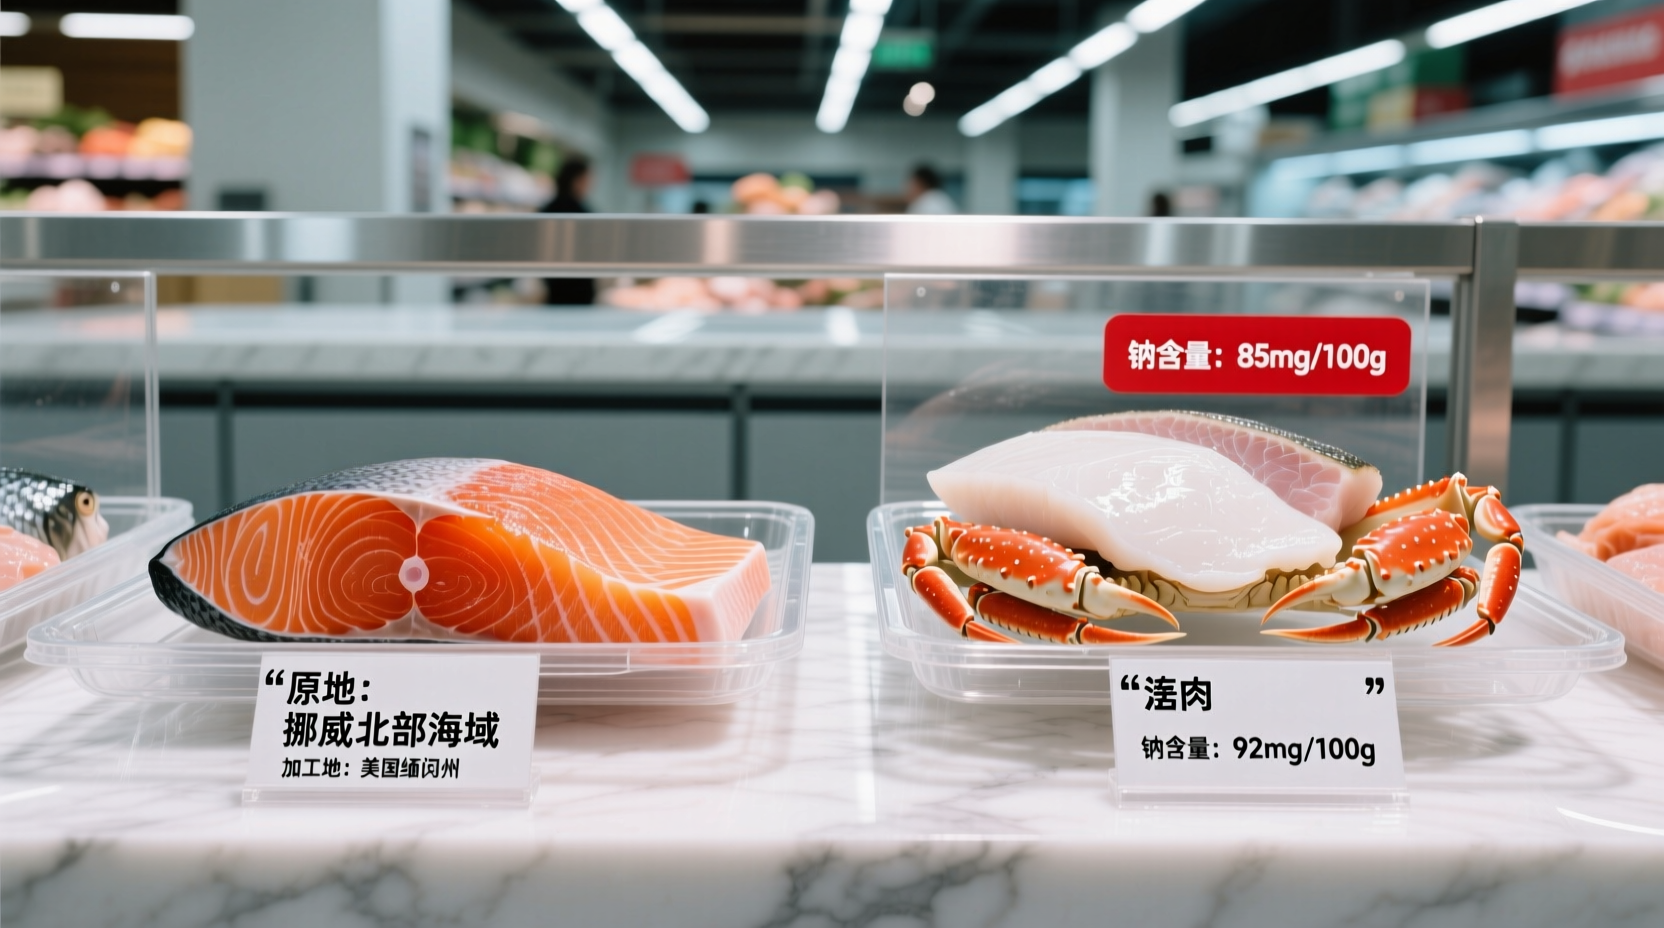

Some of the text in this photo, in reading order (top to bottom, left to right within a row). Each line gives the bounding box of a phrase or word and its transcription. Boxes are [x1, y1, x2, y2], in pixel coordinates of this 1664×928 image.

[282, 710, 500, 749] 挪威北部海域
